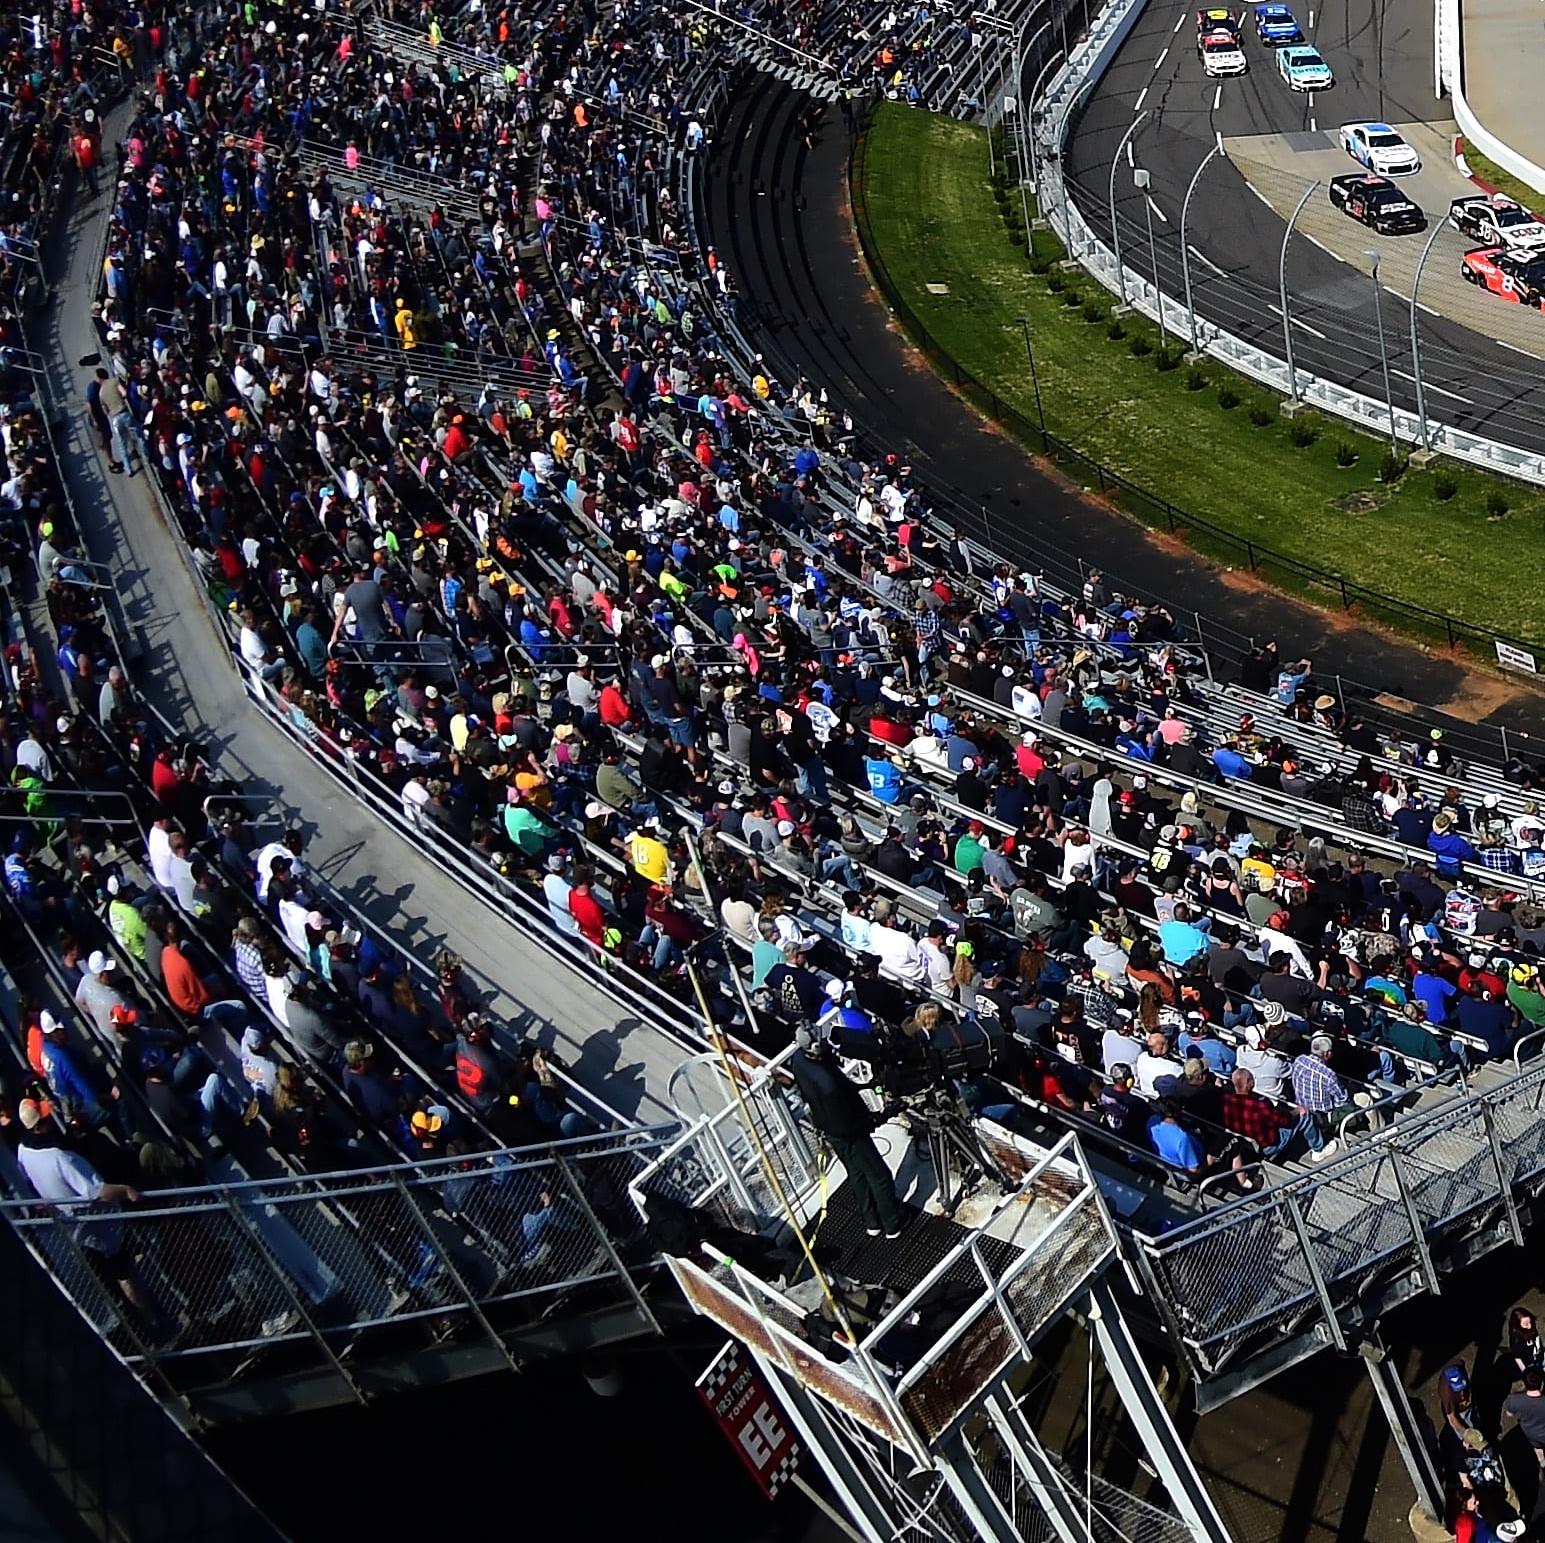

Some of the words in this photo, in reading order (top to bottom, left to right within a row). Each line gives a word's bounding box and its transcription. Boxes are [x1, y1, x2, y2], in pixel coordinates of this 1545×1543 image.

[1503, 274, 1514, 292] 8
[726, 1385, 757, 1423] TOWER
[736, 1400, 787, 1471] EE
